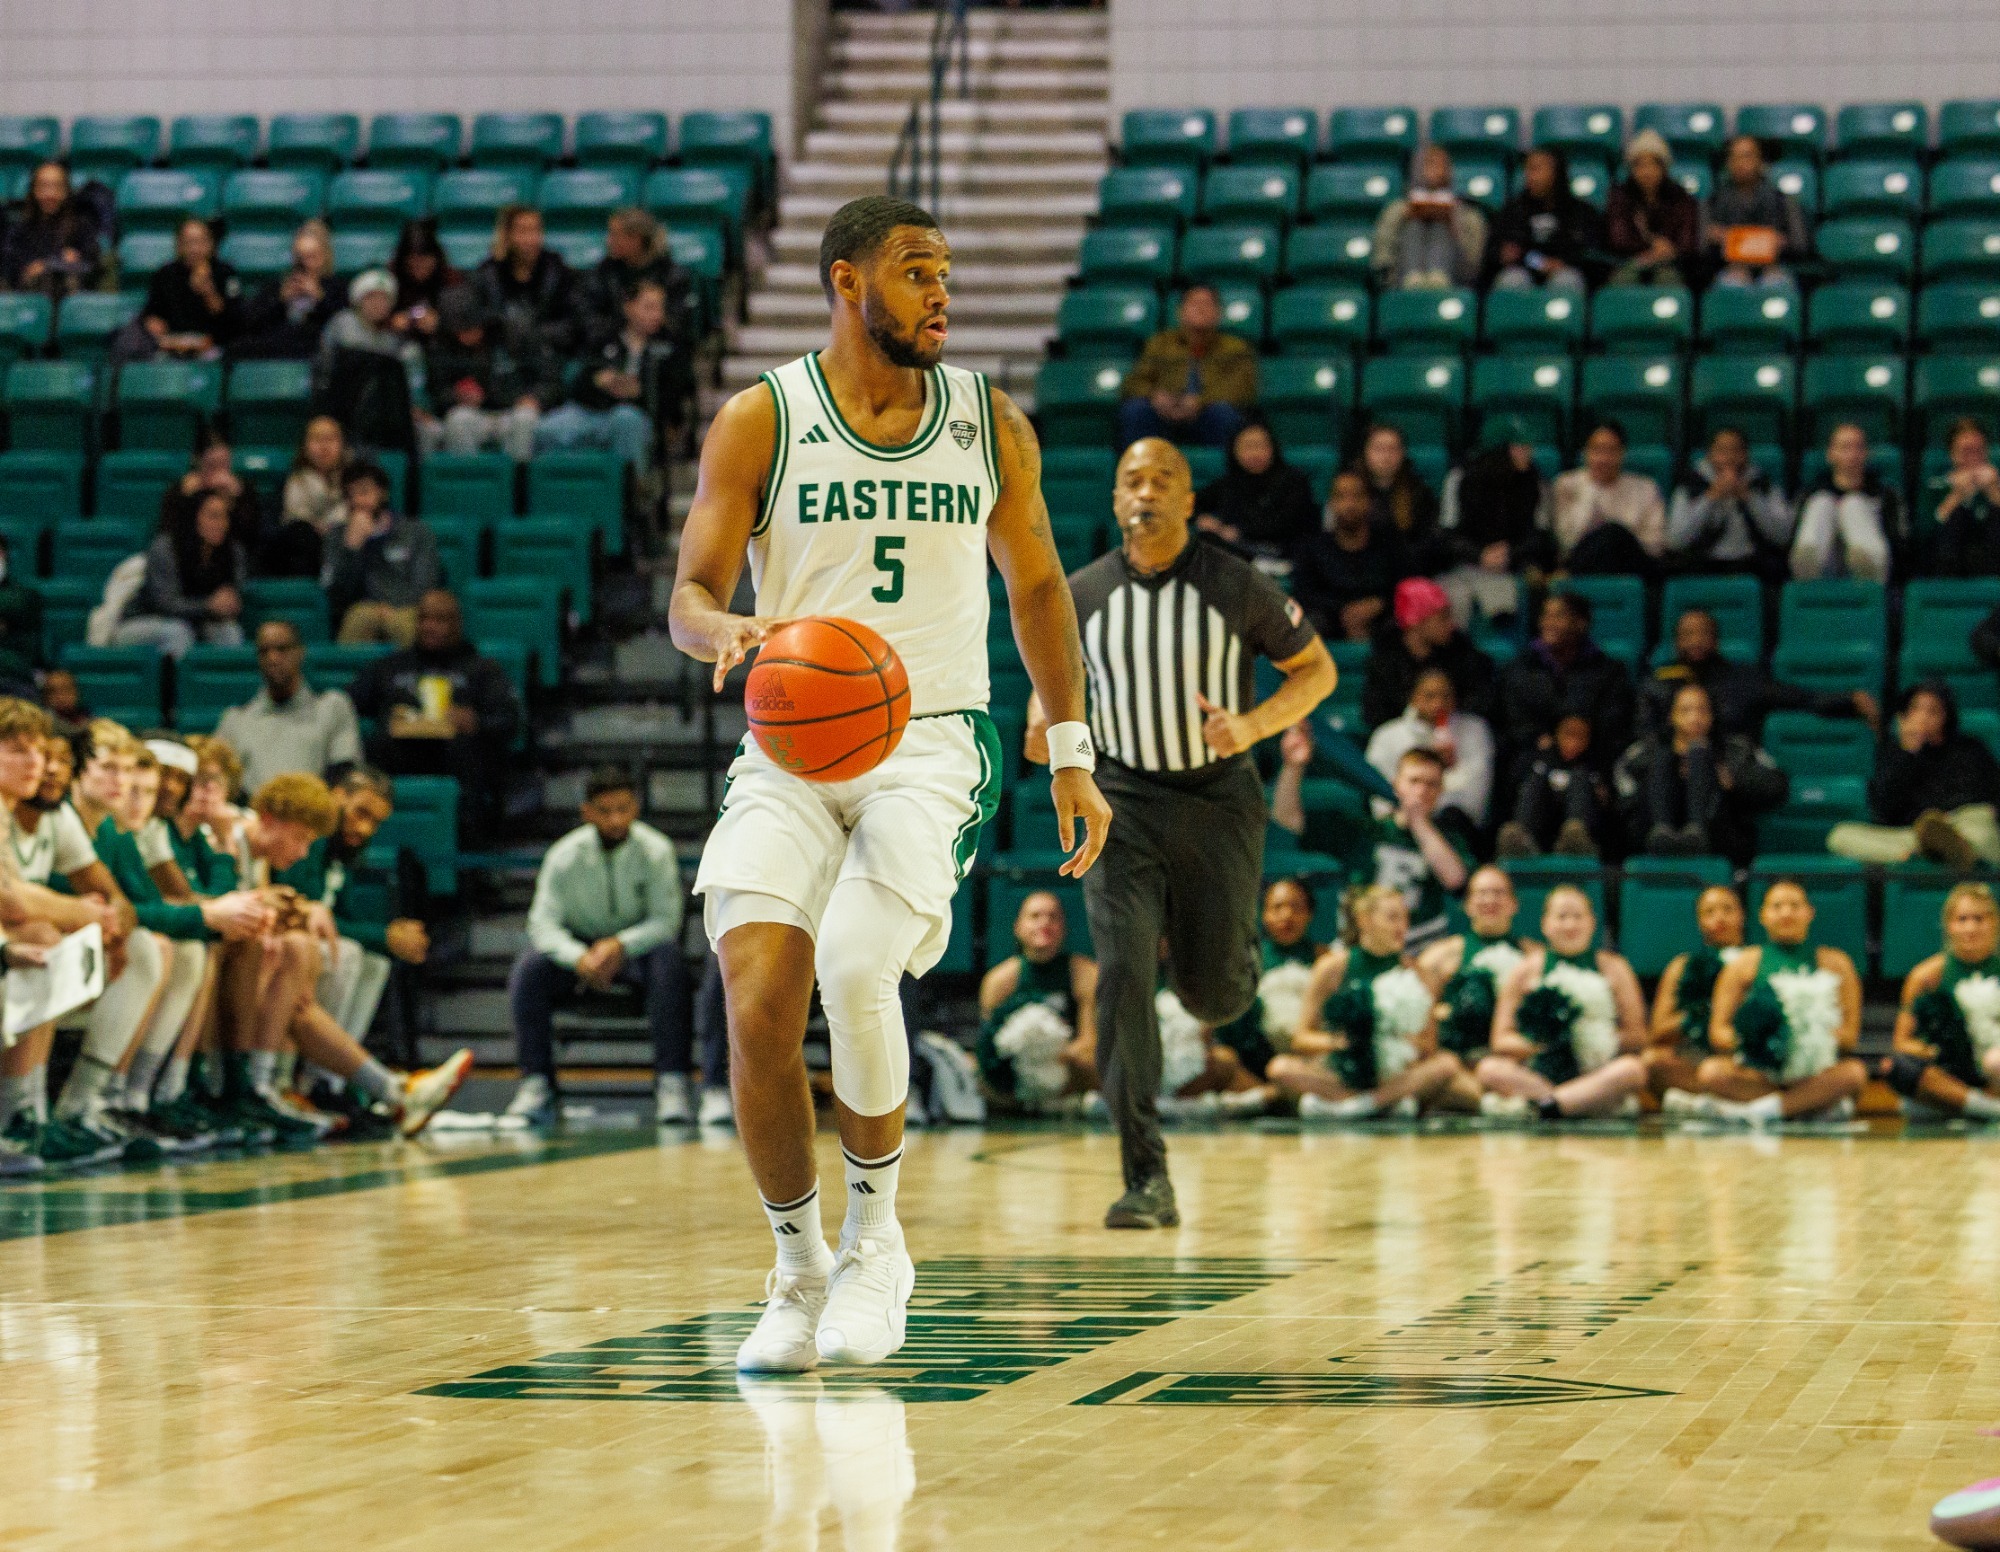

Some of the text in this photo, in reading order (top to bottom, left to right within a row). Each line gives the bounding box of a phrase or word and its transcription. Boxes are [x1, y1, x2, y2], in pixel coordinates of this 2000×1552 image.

[952, 429, 976, 438] MAC
[798, 480, 980, 524] EASTERN
[871, 536, 906, 603] 5
[753, 696, 795, 711] adidas
